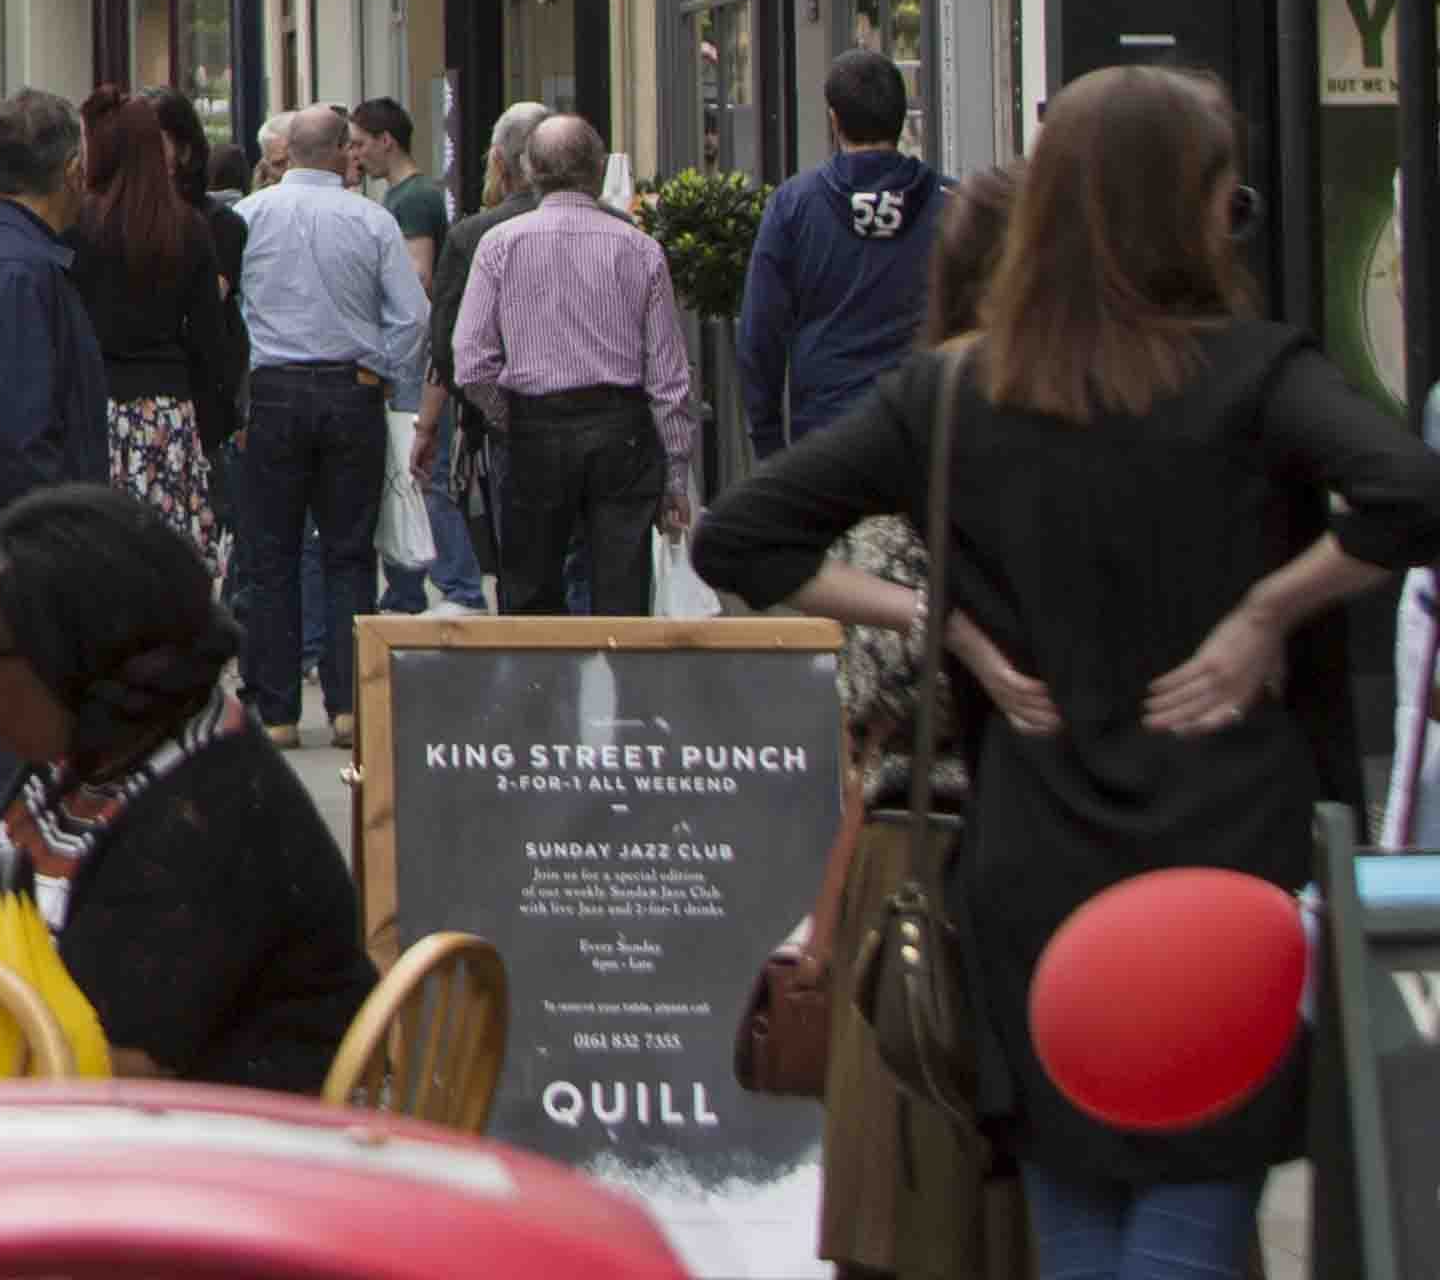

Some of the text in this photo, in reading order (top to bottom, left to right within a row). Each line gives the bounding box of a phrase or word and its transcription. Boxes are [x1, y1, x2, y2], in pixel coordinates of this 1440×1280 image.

[426, 744, 808, 772] KING STREET PUNCH
[496, 775, 738, 794] 2-FOR-1 ALL WEEKEND
[524, 842, 735, 862] SUNDAY JAZZ CLUB
[613, 867, 658, 883] special
[660, 867, 705, 881] edition
[616, 939, 663, 955] Sunday
[573, 1032, 609, 1049] 0161
[542, 1080, 719, 1127] QUILL
